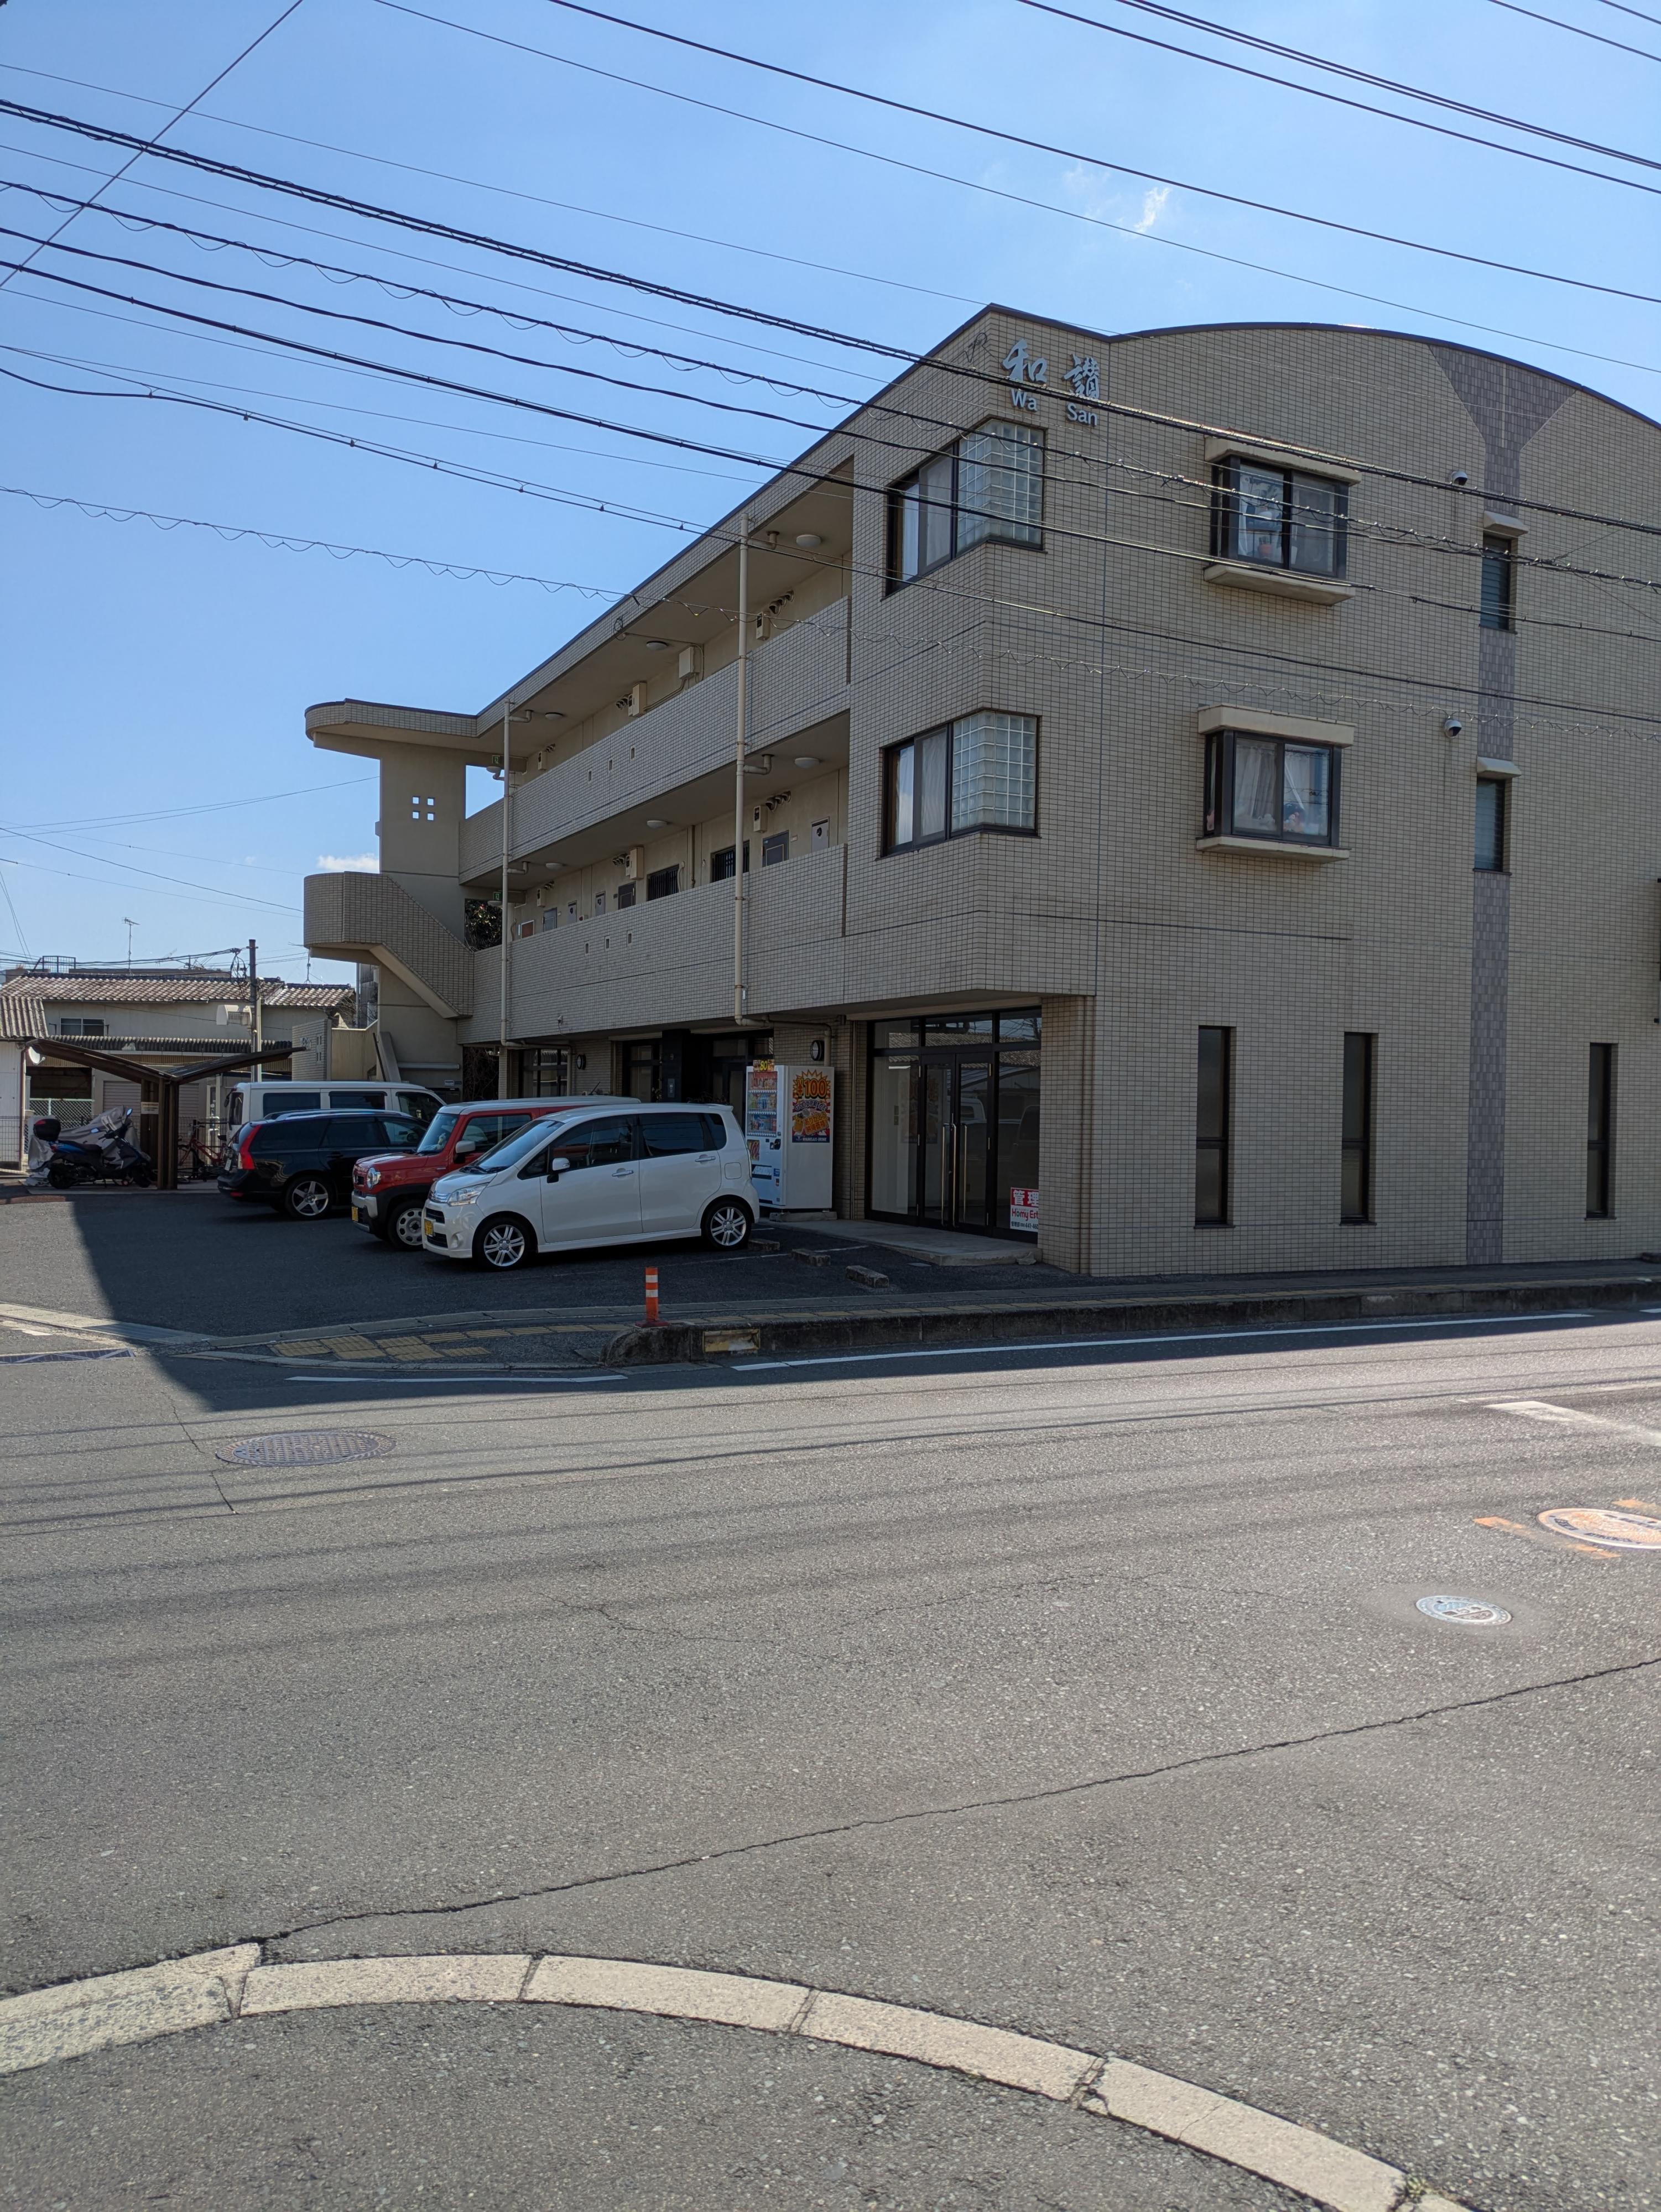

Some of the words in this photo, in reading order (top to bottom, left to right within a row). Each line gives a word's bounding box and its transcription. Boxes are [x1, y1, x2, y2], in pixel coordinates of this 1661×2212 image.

[1011, 389, 1038, 411] Wa
[1066, 403, 1098, 426] San
[796, 1078, 827, 1099] ¥100
[1013, 1189, 1039, 1207] 管理
[1012, 1208, 1029, 1222] Homy
